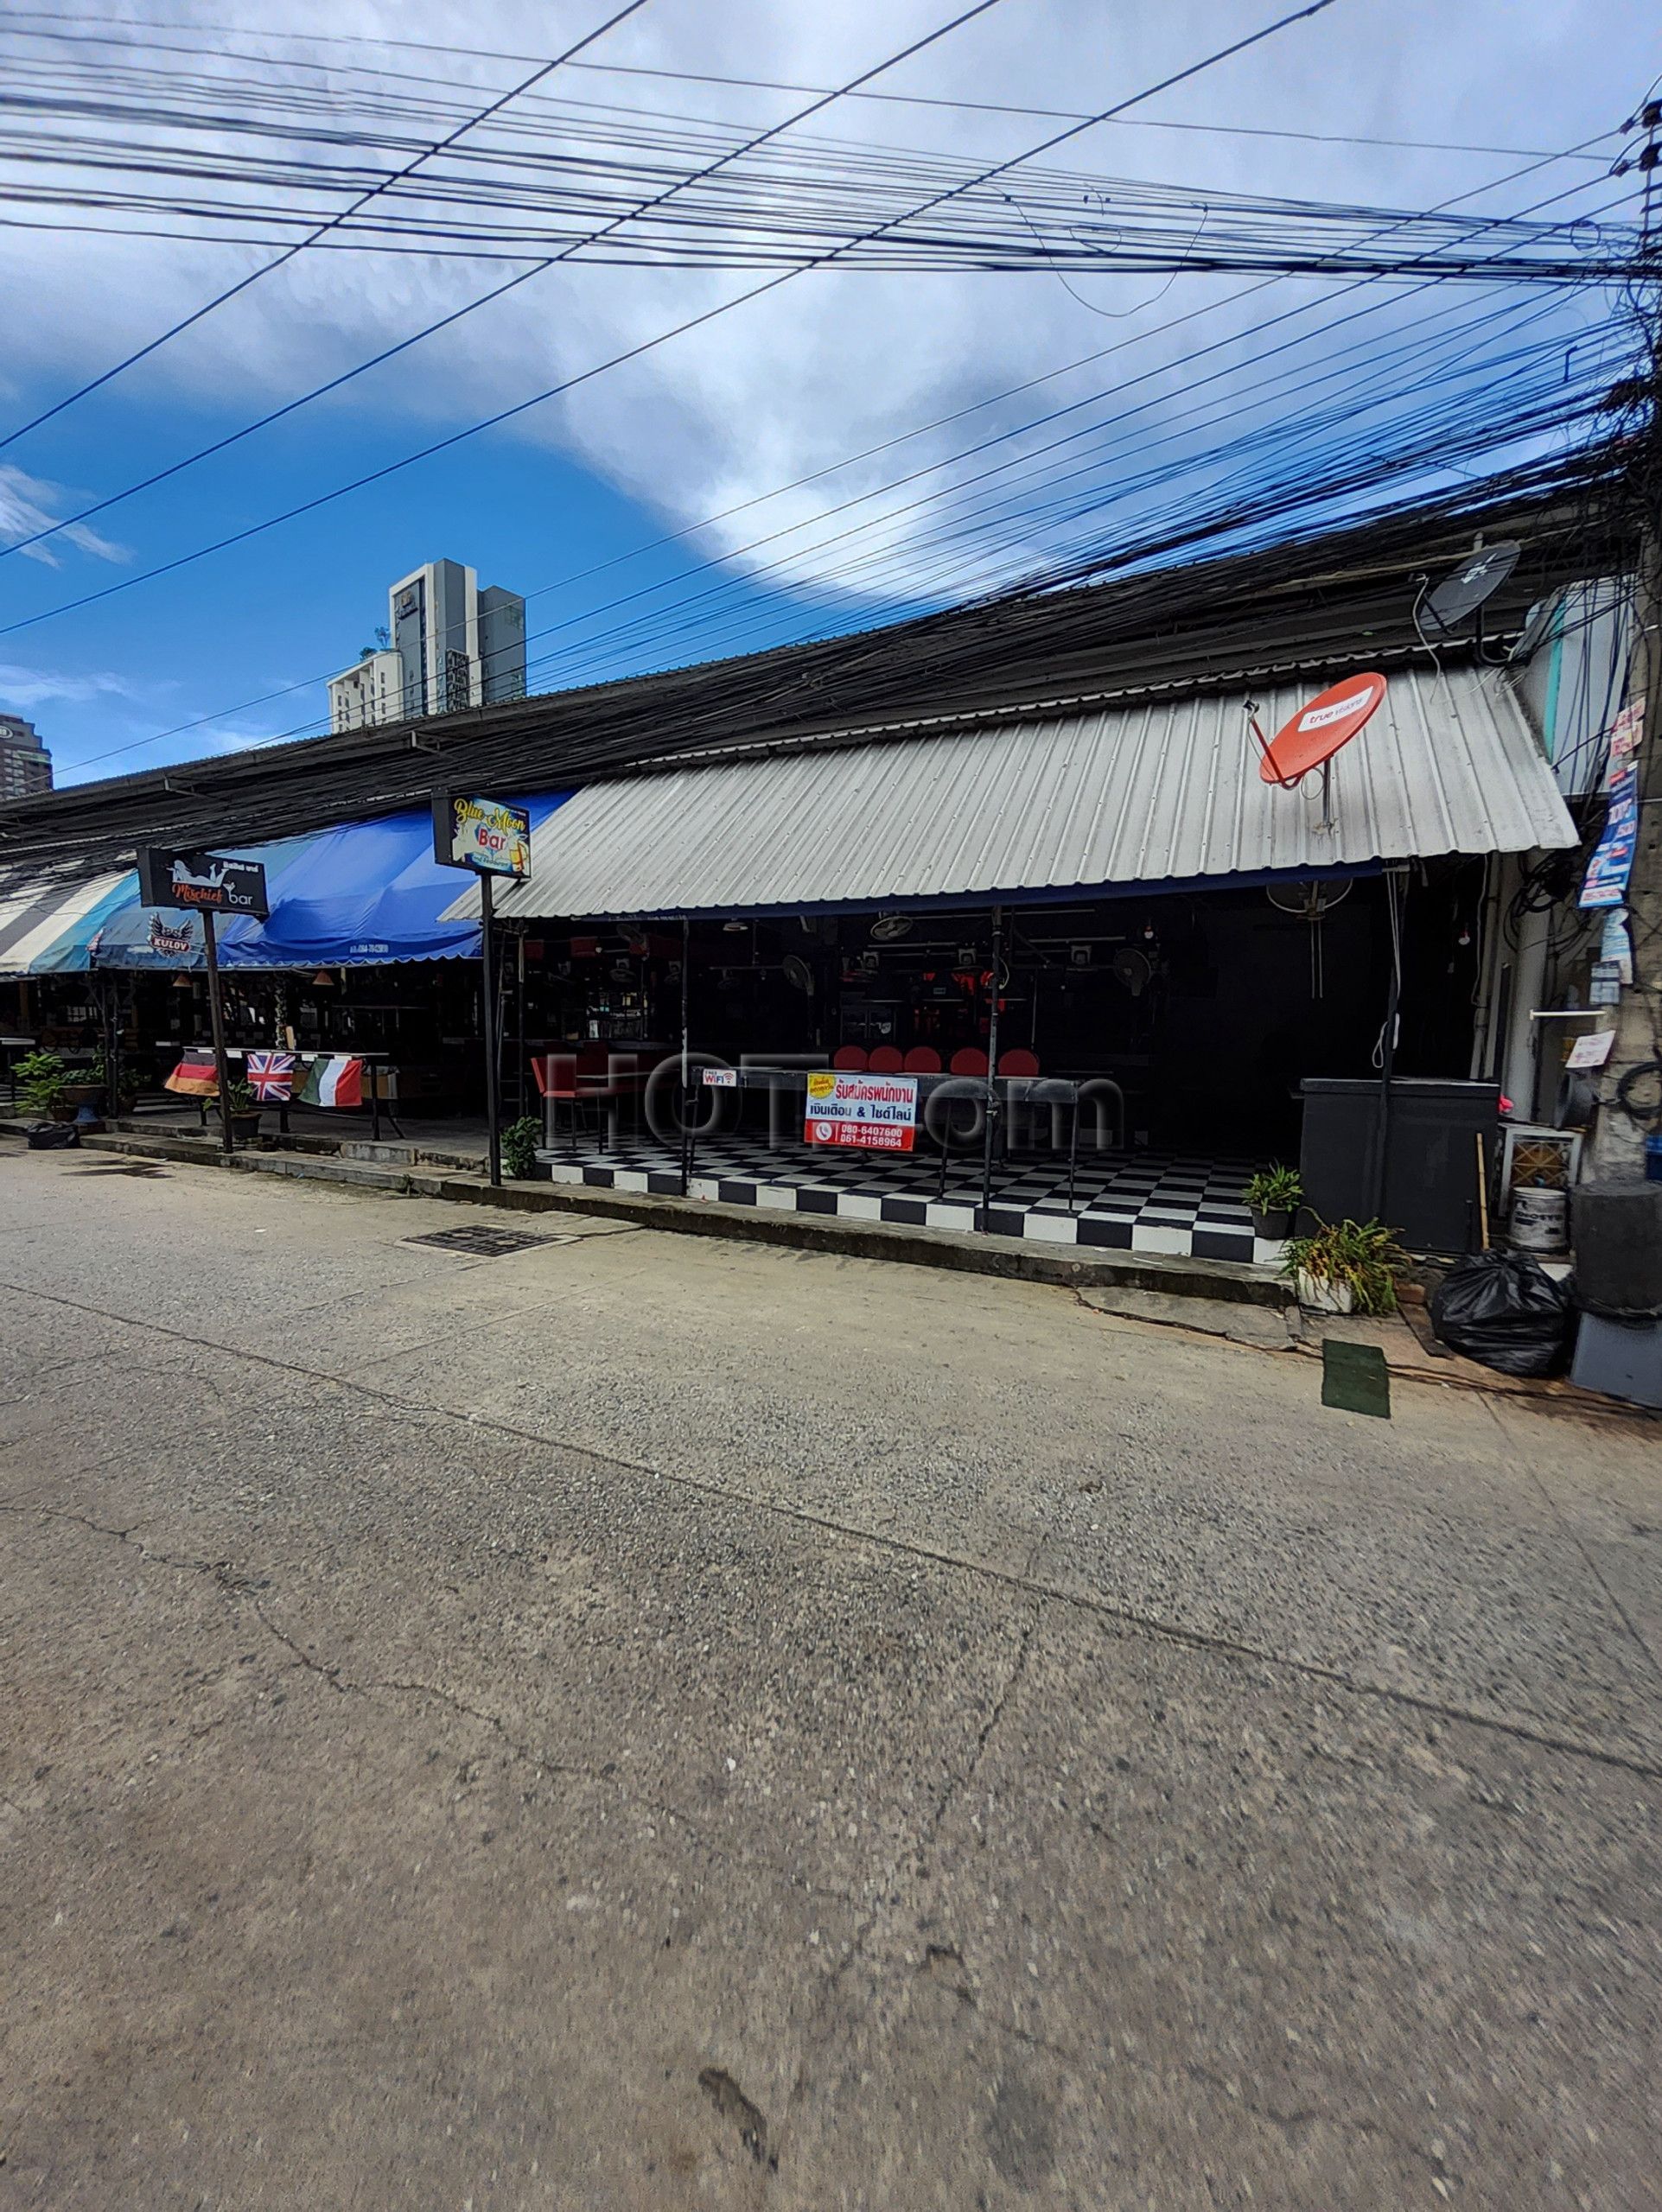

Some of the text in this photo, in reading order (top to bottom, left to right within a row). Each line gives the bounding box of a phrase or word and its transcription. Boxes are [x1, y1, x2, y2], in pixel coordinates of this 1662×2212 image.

[1309, 697, 1363, 724] true visions
[454, 798, 525, 836] Blue Moon
[478, 828, 506, 850] Bar
[172, 884, 253, 905] Mischief bar
[153, 938, 188, 950] KULOV
[835, 1078, 914, 1103] รับสมัครพนักงาน
[810, 1103, 852, 1117] เงินเดือน
[856, 1106, 866, 1118] &
[840, 1134, 902, 1147] 061-4158964
[841, 1124, 903, 1138] 080-6407600
